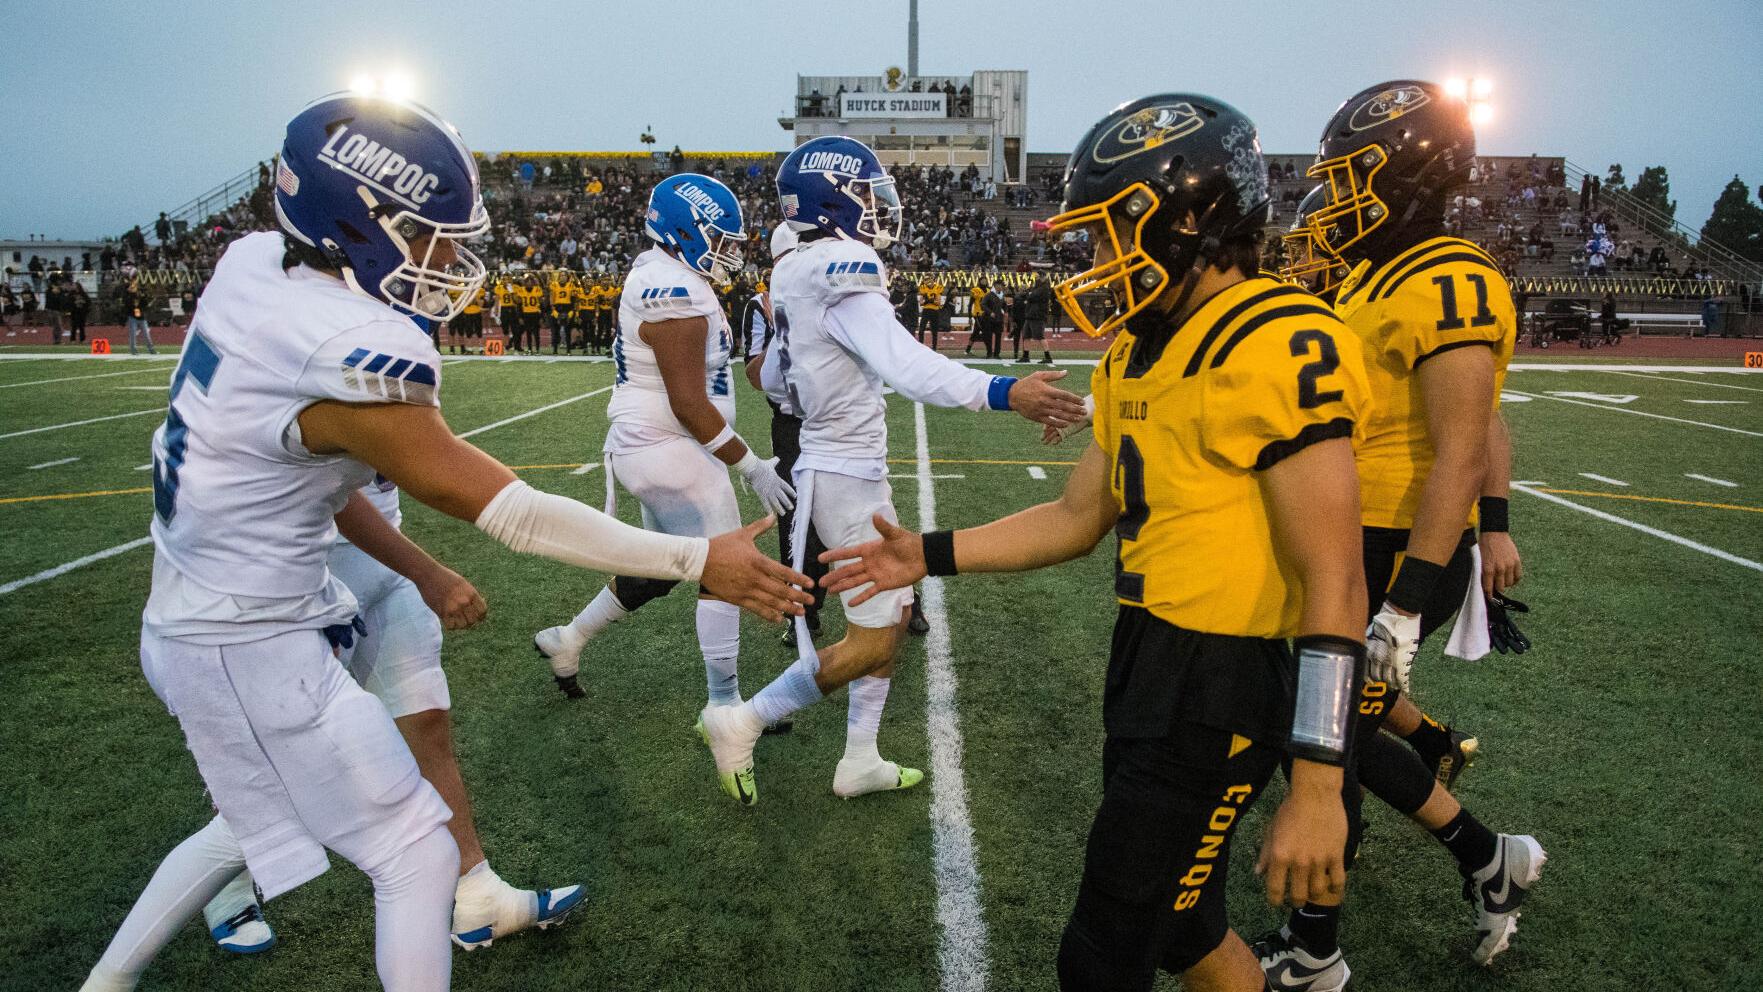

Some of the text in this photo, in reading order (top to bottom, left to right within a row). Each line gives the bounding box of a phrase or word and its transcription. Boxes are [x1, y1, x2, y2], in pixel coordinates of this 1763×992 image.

[846, 99, 941, 111] HUYCK STADIUM
[319, 124, 440, 204] LOMPOC
[799, 151, 863, 175] LOMPOC
[676, 181, 725, 221] LOMPOC
[1431, 273, 1497, 331] 11
[94, 340, 106, 353] 30
[487, 342, 500, 355] 40
[1748, 354, 1763, 368] 30
[1288, 328, 1345, 410] 2
[1173, 783, 1253, 911] CONQS
